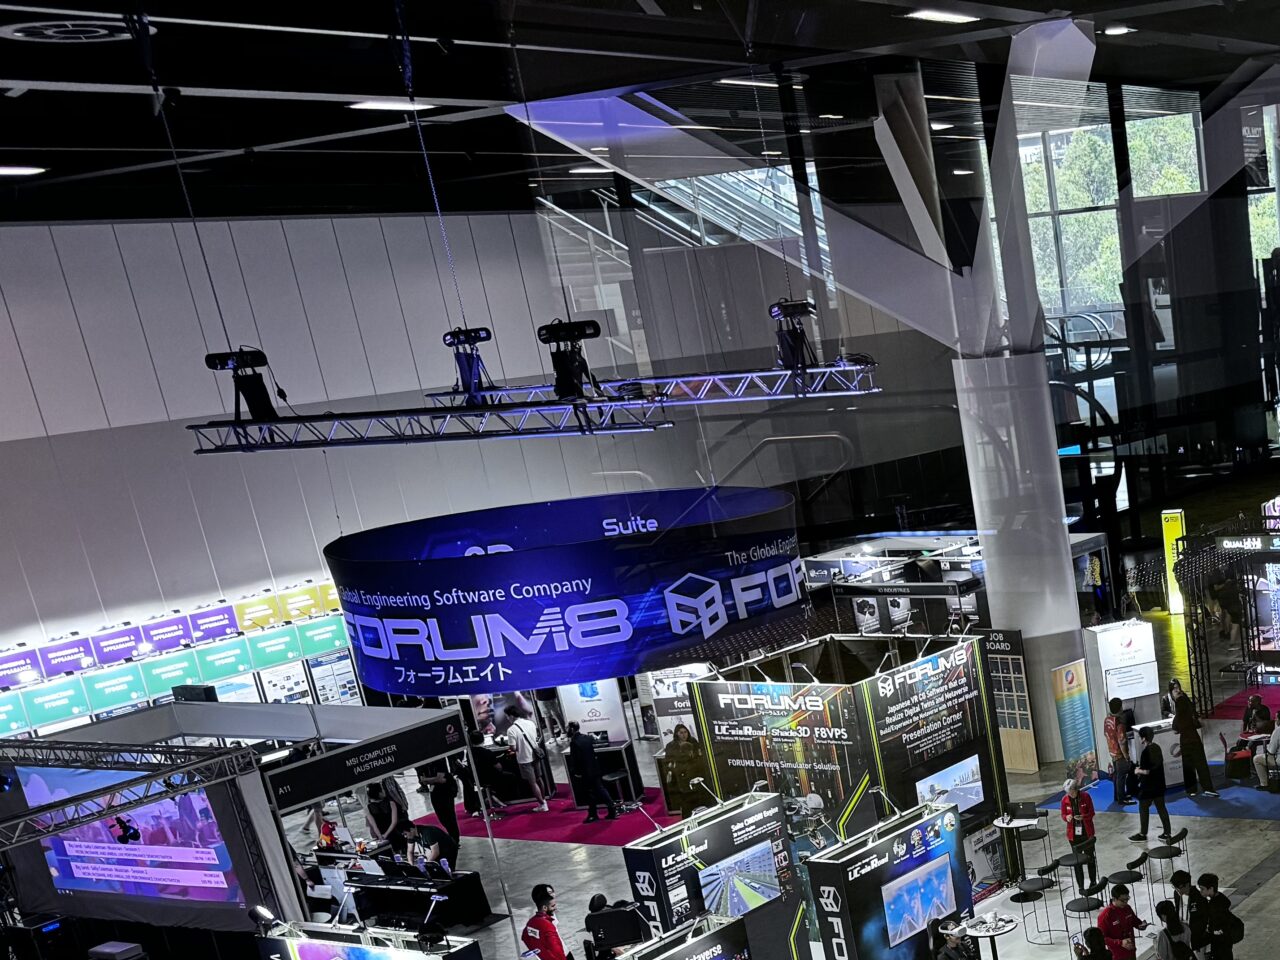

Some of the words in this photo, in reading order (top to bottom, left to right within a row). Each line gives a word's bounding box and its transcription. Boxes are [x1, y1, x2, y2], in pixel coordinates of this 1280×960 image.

[602, 516, 659, 537] Suite
[725, 550, 748, 566] The
[750, 541, 778, 561] Global
[360, 591, 431, 610] Engineering
[433, 585, 506, 607] Software
[511, 576, 593, 601] Company
[989, 632, 1004, 641] JOB
[393, 662, 513, 685] フォーラムエイト
[894, 649, 967, 689] FORUM8
[718, 693, 824, 711] FORUM8
[885, 709, 903, 726] Realize
[904, 703, 920, 718] Digital
[921, 697, 934, 711] Twins
[935, 694, 944, 704] and
[944, 682, 968, 701] Metaverse
[887, 696, 910, 716] Japanese
[926, 681, 947, 699] Software
[814, 728, 848, 739] F8VPS
[902, 715, 941, 747] Presentation
[942, 707, 963, 727] Corner
[345, 757, 360, 767] MSI
[360, 744, 398, 763] COMPUTER
[353, 755, 395, 775] (AUSTRALIA)
[728, 759, 755, 767] FORUM8
[756, 759, 780, 769] Driving
[780, 761, 812, 770] Simulator
[813, 762, 841, 771] Solution
[278, 785, 292, 795] A11
